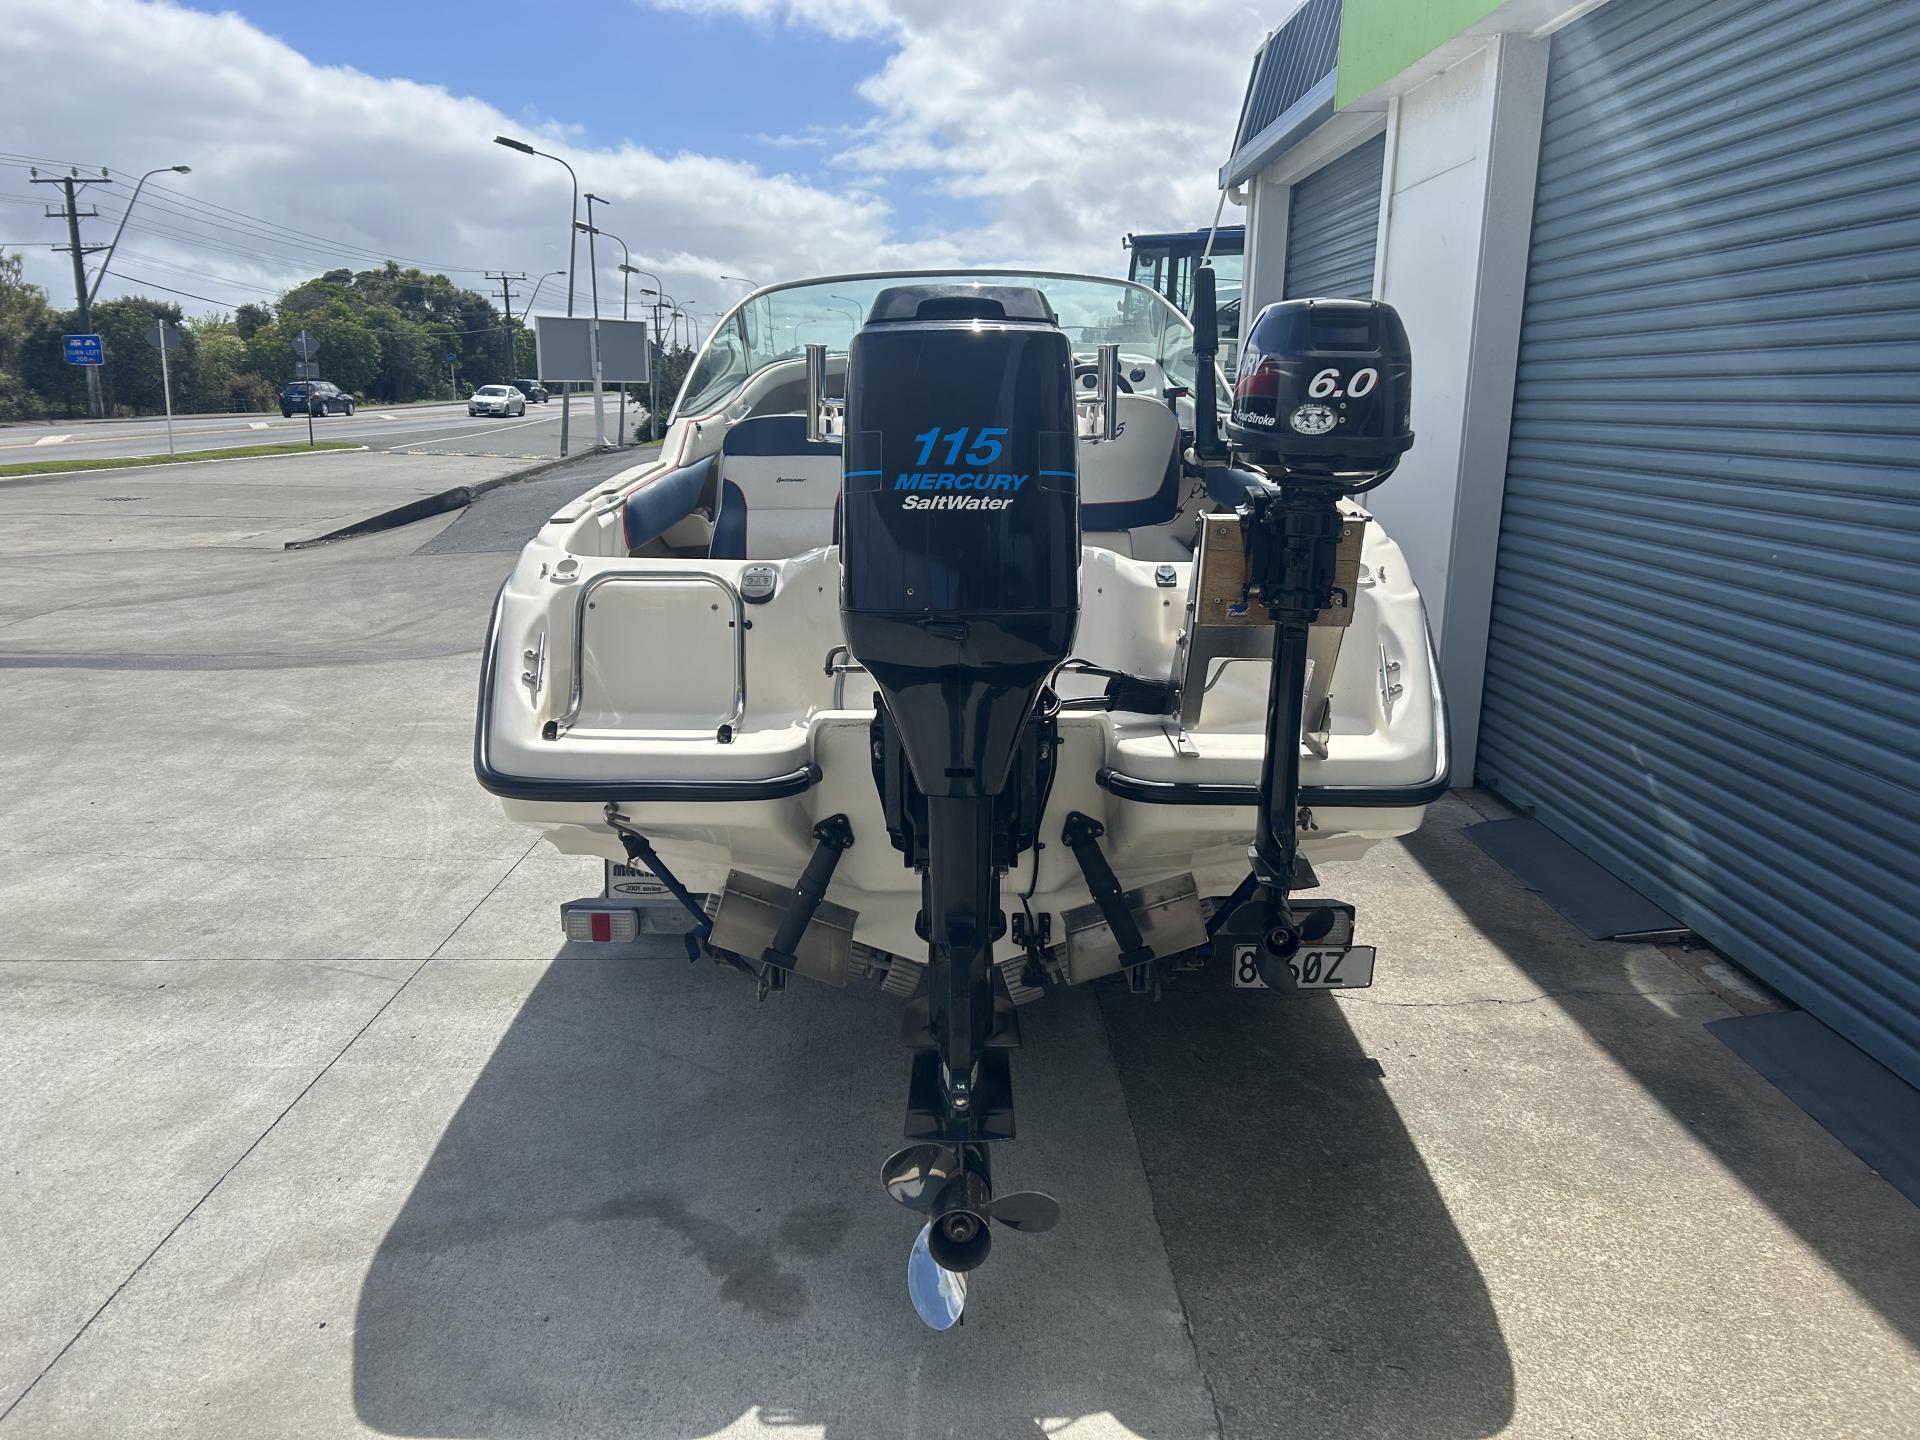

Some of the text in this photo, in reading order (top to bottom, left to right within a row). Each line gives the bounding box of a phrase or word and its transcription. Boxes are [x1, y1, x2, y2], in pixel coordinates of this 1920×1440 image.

[1308, 367, 1378, 399] 6.0
[915, 426, 1009, 466] 115
[894, 473, 1029, 490] MERCURY
[902, 495, 1013, 510] SaltWater
